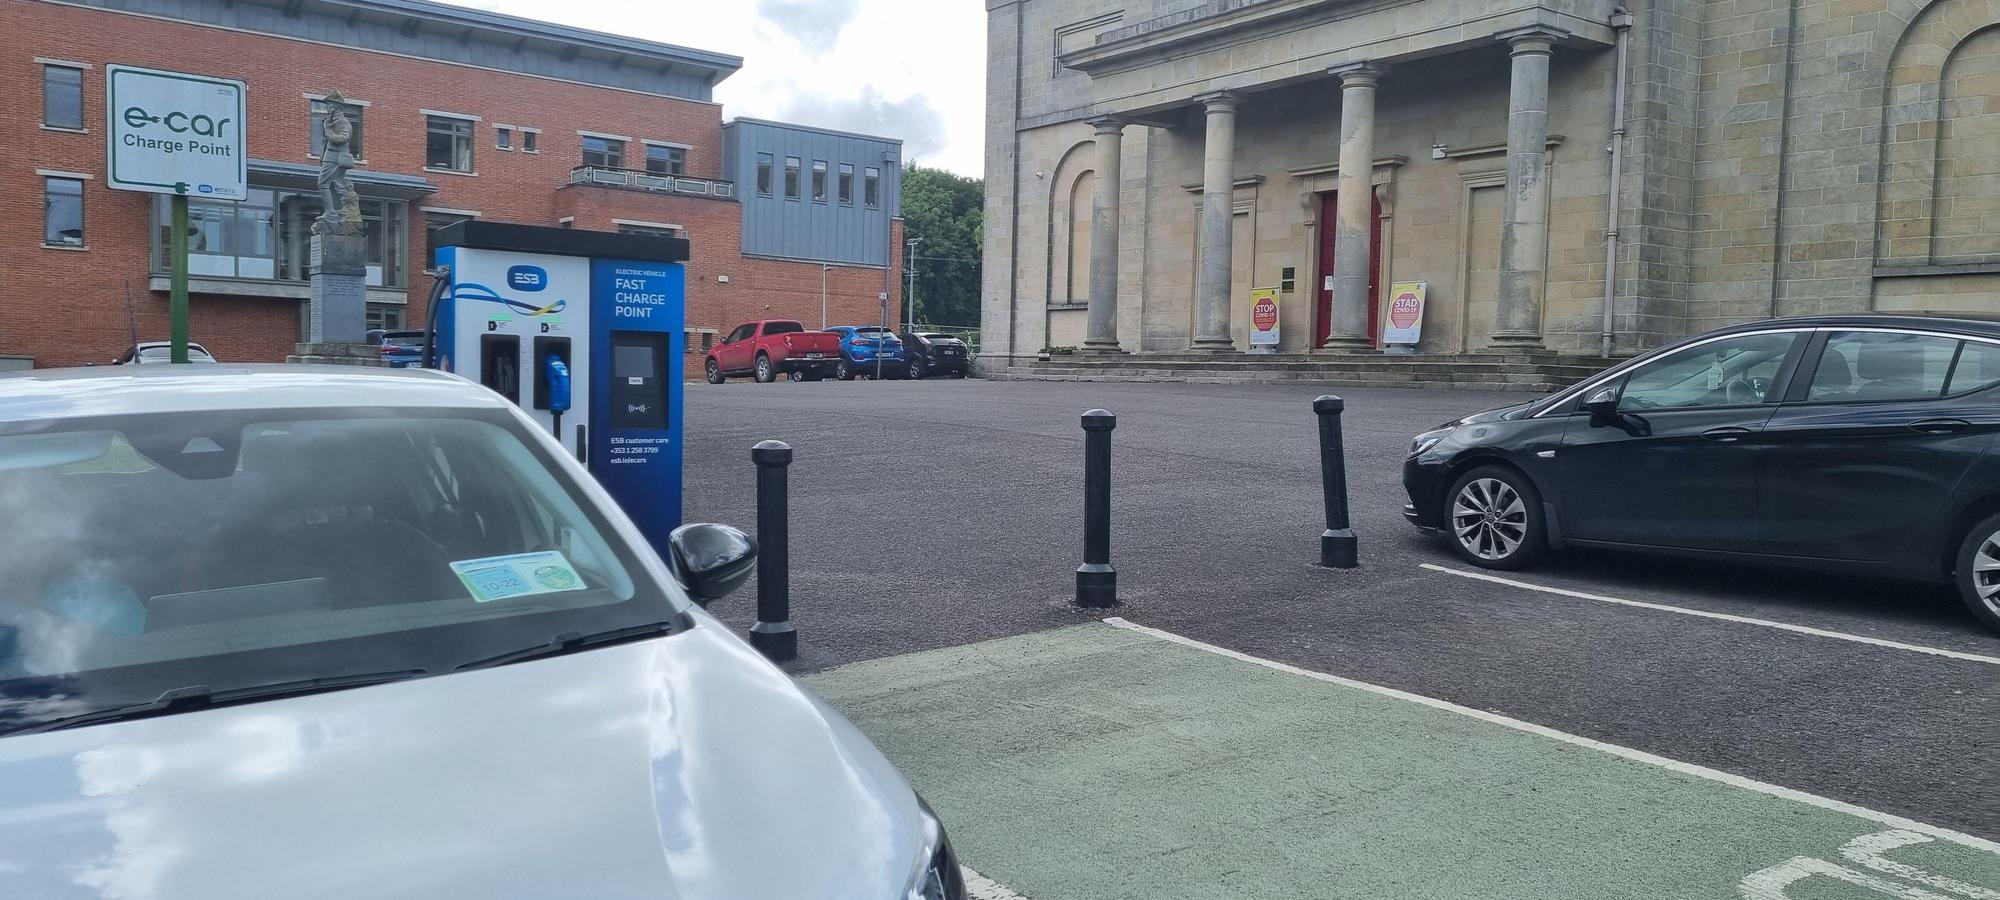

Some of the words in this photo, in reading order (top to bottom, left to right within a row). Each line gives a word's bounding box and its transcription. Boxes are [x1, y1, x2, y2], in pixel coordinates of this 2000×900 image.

[123, 133, 183, 153] Charge
[189, 140, 231, 157] Point
[514, 272, 540, 285] ESB
[644, 270, 667, 278] VEHICLE
[615, 278, 647, 290] FAST
[615, 292, 666, 305] CHARGE
[1395, 299, 1417, 308] STAD
[615, 305, 653, 318] POINT
[1256, 304, 1275, 313] STOP
[483, 577, 521, 592] 10-22
